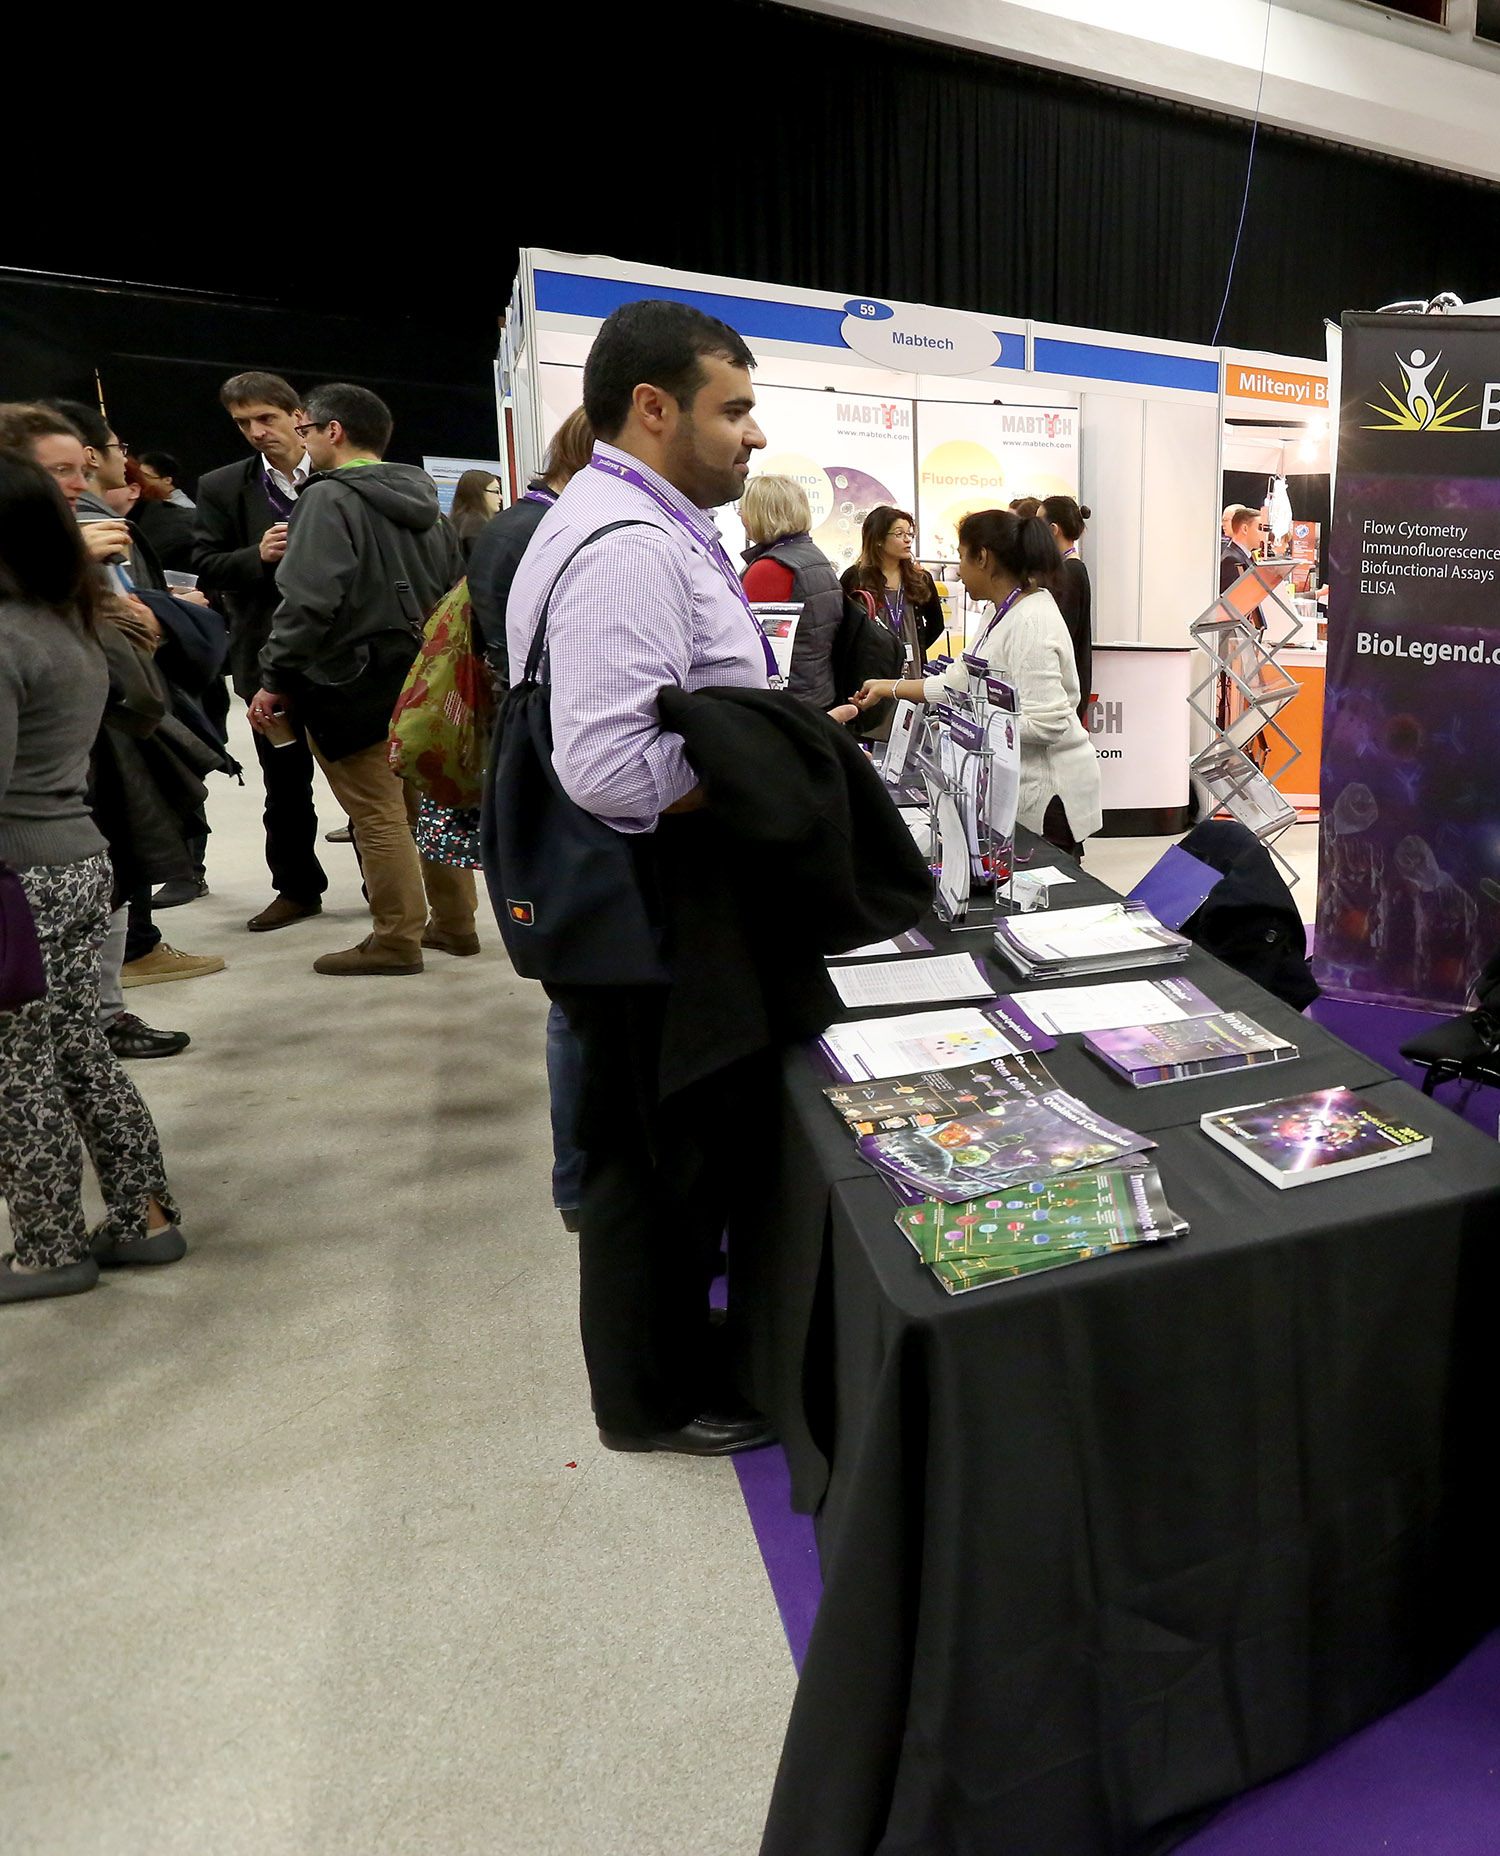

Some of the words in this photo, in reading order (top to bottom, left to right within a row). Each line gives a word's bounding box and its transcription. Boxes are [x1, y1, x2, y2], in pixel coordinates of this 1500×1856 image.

[860, 303, 876, 316] 59
[892, 331, 954, 350] Mabtech
[1238, 372, 1311, 402] Miltenyi
[836, 403, 910, 430] MABTECH
[1001, 413, 1073, 438] MABTECH
[836, 429, 910, 441] www.mabtech.com
[1002, 439, 1073, 449] www.mabtech.com
[921, 472, 1004, 488] FluoroSpot
[1363, 520, 1396, 535] Flow
[1398, 521, 1468, 541] Cytometry
[1361, 560, 1449, 579] Biofunctional
[1451, 565, 1495, 583] Assays
[1360, 580, 1396, 595] ELISA
[991, 1058, 1011, 1077] Stem
[1130, 1173, 1158, 1230] Immunologic
